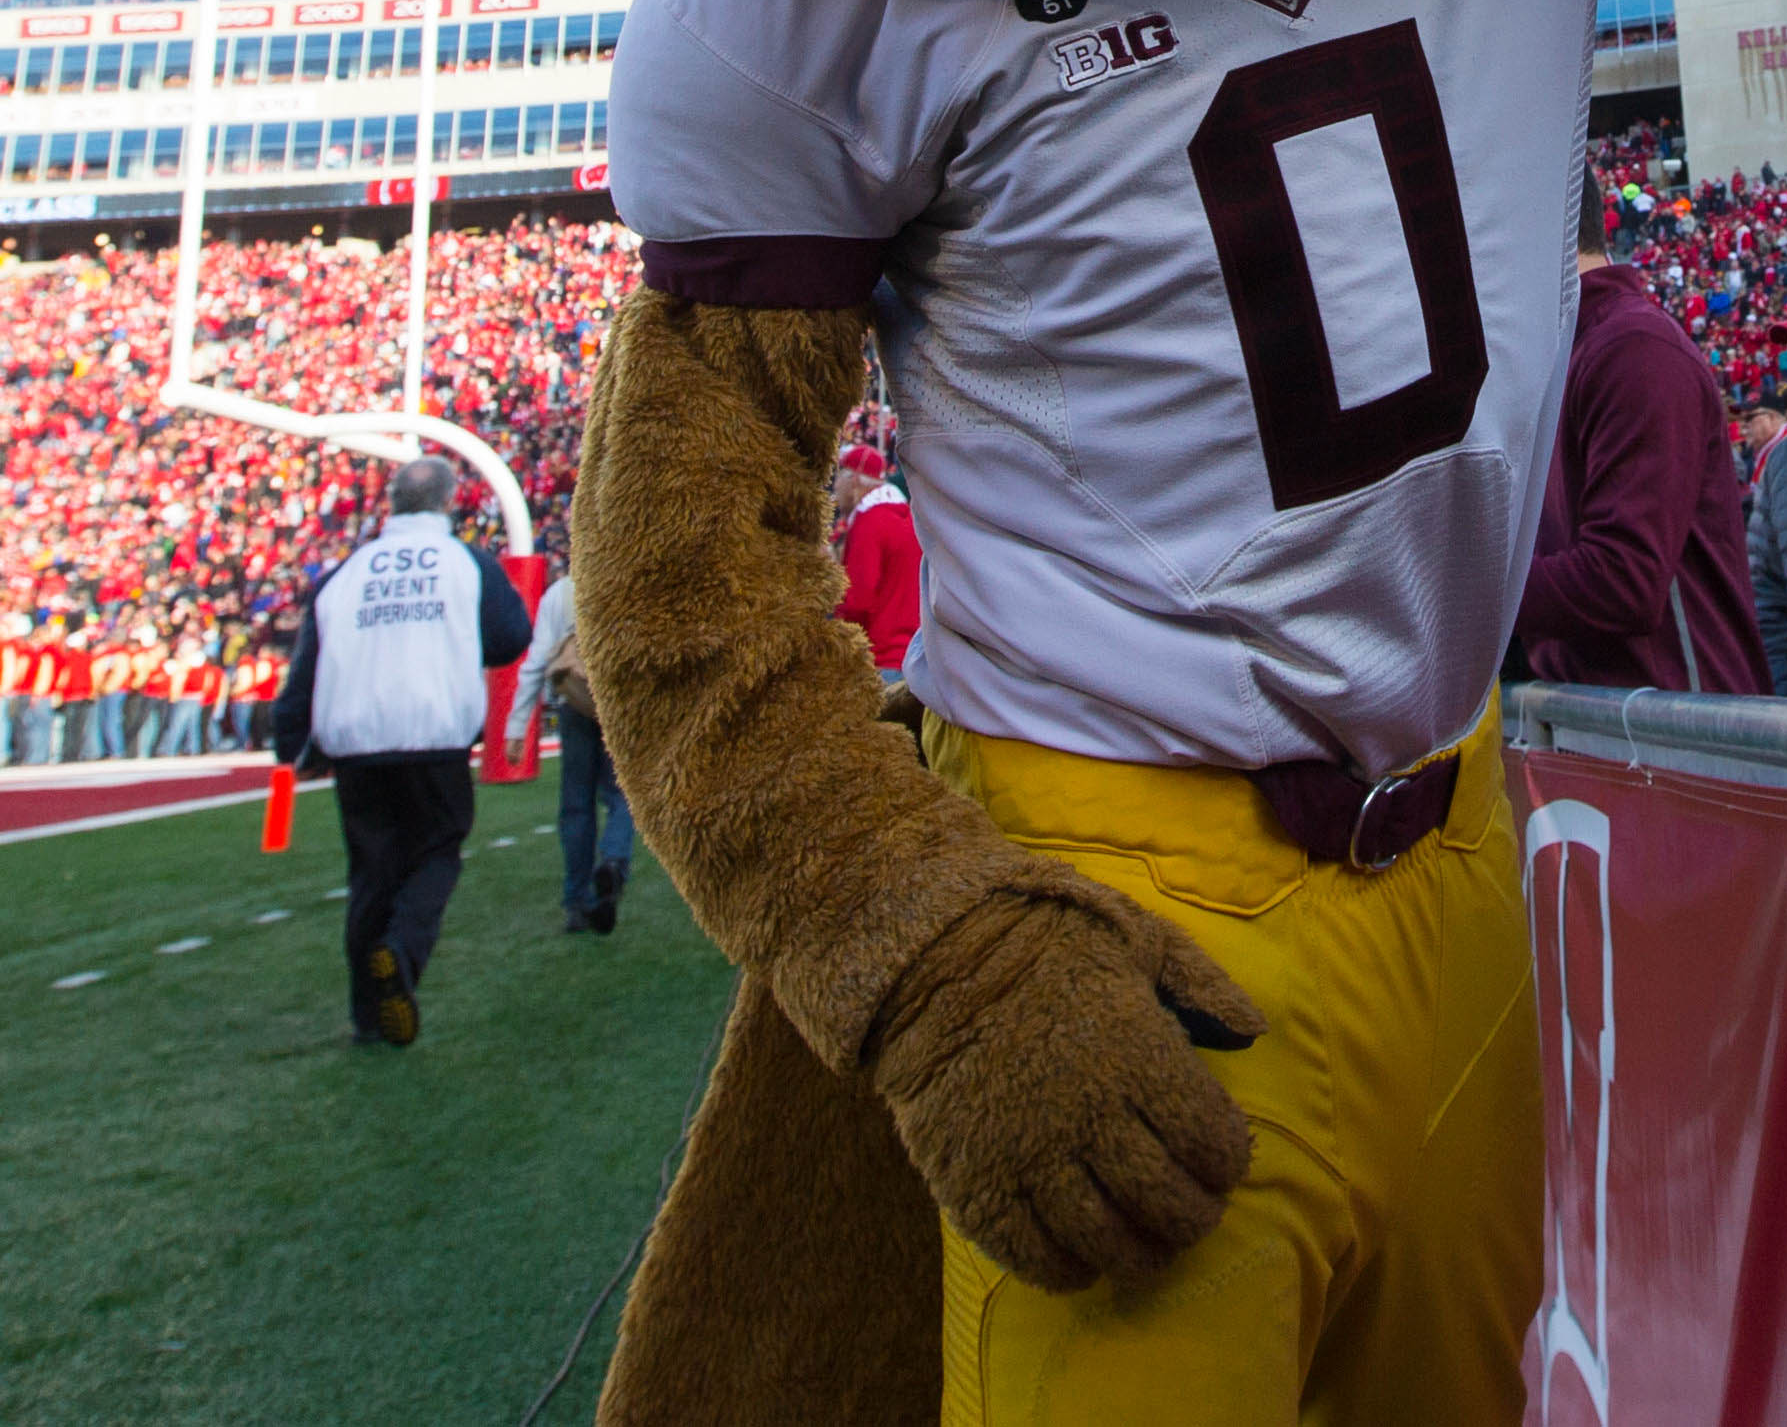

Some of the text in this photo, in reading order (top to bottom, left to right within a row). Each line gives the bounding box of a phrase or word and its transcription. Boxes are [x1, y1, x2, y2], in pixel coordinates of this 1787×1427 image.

[298, 4, 359, 22] 2010
[1187, 17, 1489, 511] 0
[370, 547, 440, 574] CSC
[363, 575, 439, 602] EVENT
[356, 601, 445, 629] SUPERVISOR
